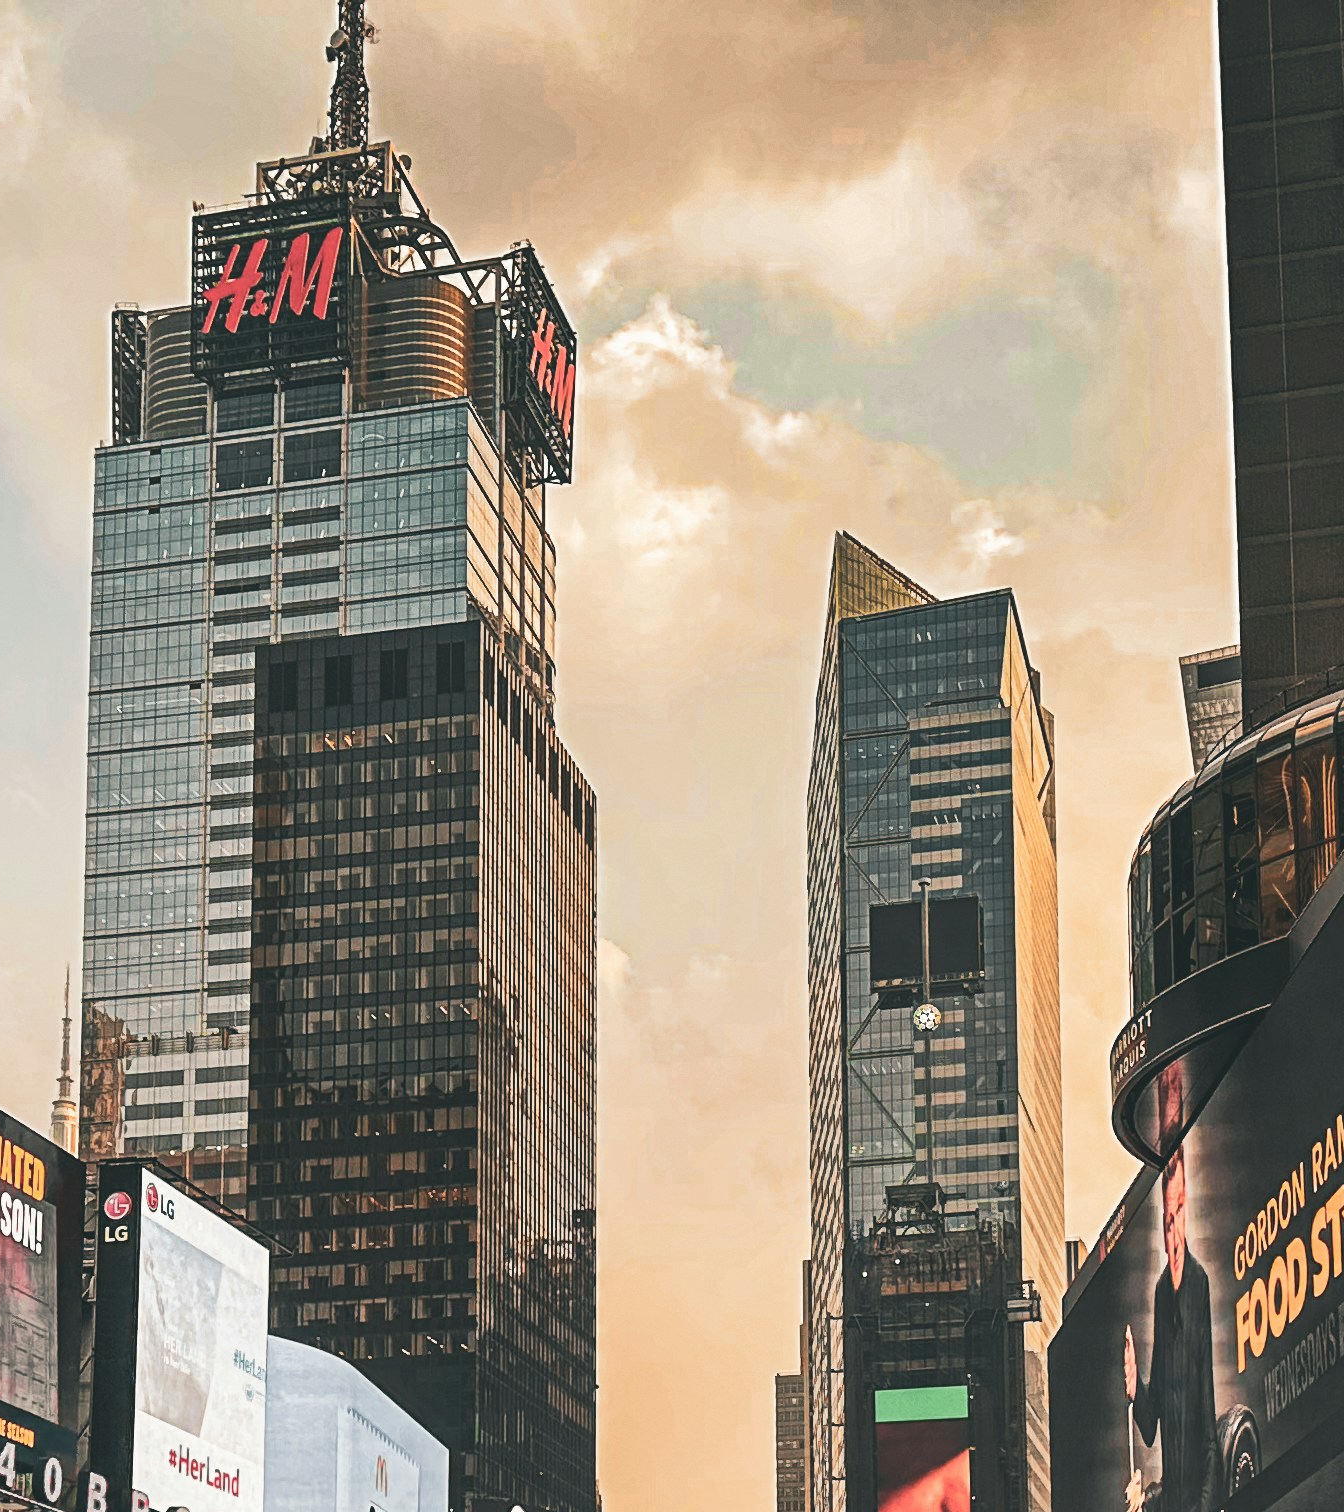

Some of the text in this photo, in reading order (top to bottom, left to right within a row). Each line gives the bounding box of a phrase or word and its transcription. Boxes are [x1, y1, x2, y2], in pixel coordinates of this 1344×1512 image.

[202, 226, 344, 334] H&M
[529, 308, 576, 439] H&M
[104, 1225, 129, 1243] LG
[160, 1194, 175, 1220] LG
[1234, 1162, 1306, 1281] GORDON
[1235, 1237, 1309, 1374] FOOD
[1264, 1317, 1338, 1423] WEDNESDAYS
[6, 1420, 36, 1448] SEASON
[168, 1444, 240, 1499] #HerLand
